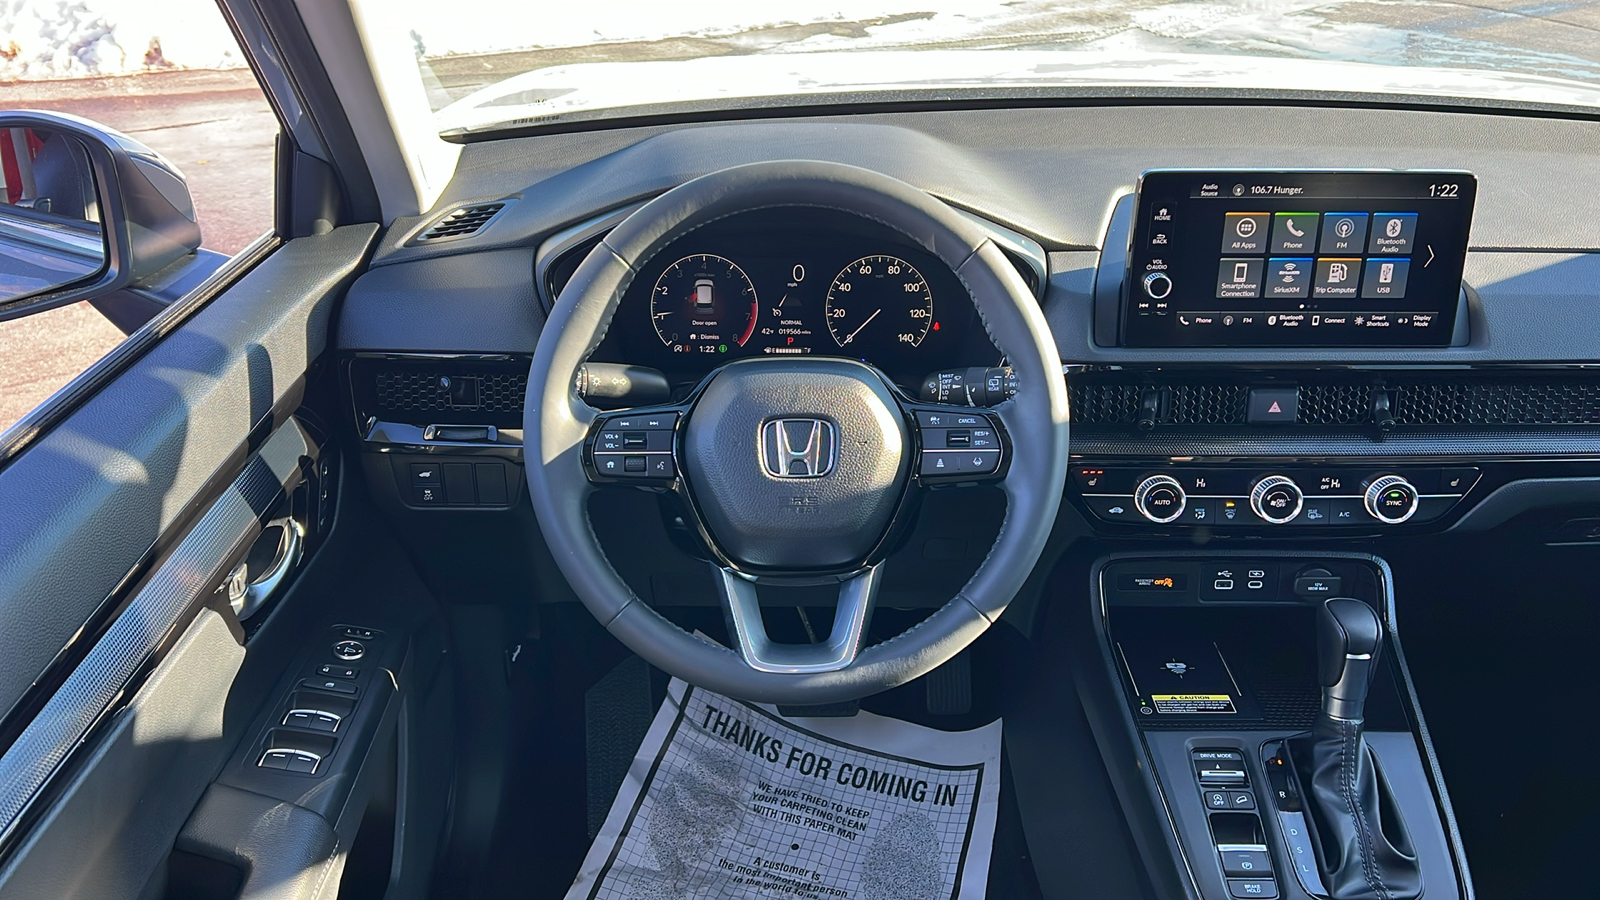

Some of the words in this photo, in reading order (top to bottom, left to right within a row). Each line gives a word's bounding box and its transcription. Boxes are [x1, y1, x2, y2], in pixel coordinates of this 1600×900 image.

[1250, 186, 1272, 194] 106.7
[1274, 186, 1304, 196] Hunger.
[1429, 184, 1459, 198] 1:22
[792, 264, 805, 282] 0
[859, 266, 872, 274] 60
[888, 266, 900, 274] 80
[662, 287, 668, 295] 2
[839, 283, 851, 292] 40
[903, 283, 919, 292] 100
[833, 309, 846, 318] 20
[909, 309, 926, 318] 120
[787, 337, 794, 345] P
[898, 334, 914, 342] 140
[702, 704, 784, 764] THANKS
[785, 747, 832, 781] FOR
[836, 762, 928, 803] COMING
[933, 784, 959, 807] IN
[758, 780, 772, 794] WE
[774, 787, 799, 799] HAVE
[800, 792, 828, 808] TRIED
[831, 802, 843, 812] TO
[845, 806, 870, 819] KEEP
[753, 792, 778, 805] YOUR
[780, 798, 833, 821] CARPETING
[835, 816, 867, 832] CLEAN
[753, 804, 777, 819] WITH
[780, 811, 801, 824] THIS
[804, 818, 834, 833] PAPER
[837, 828, 858, 841] MAT
[753, 856, 761, 866] A
[763, 860, 809, 878] customer
[718, 858, 734, 870] the
[736, 864, 761, 877] most
[762, 870, 812, 892] important
[813, 885, 848, 898] person
[746, 878, 761, 886] the
[764, 881, 792, 893] world
[794, 888, 804, 897] to
